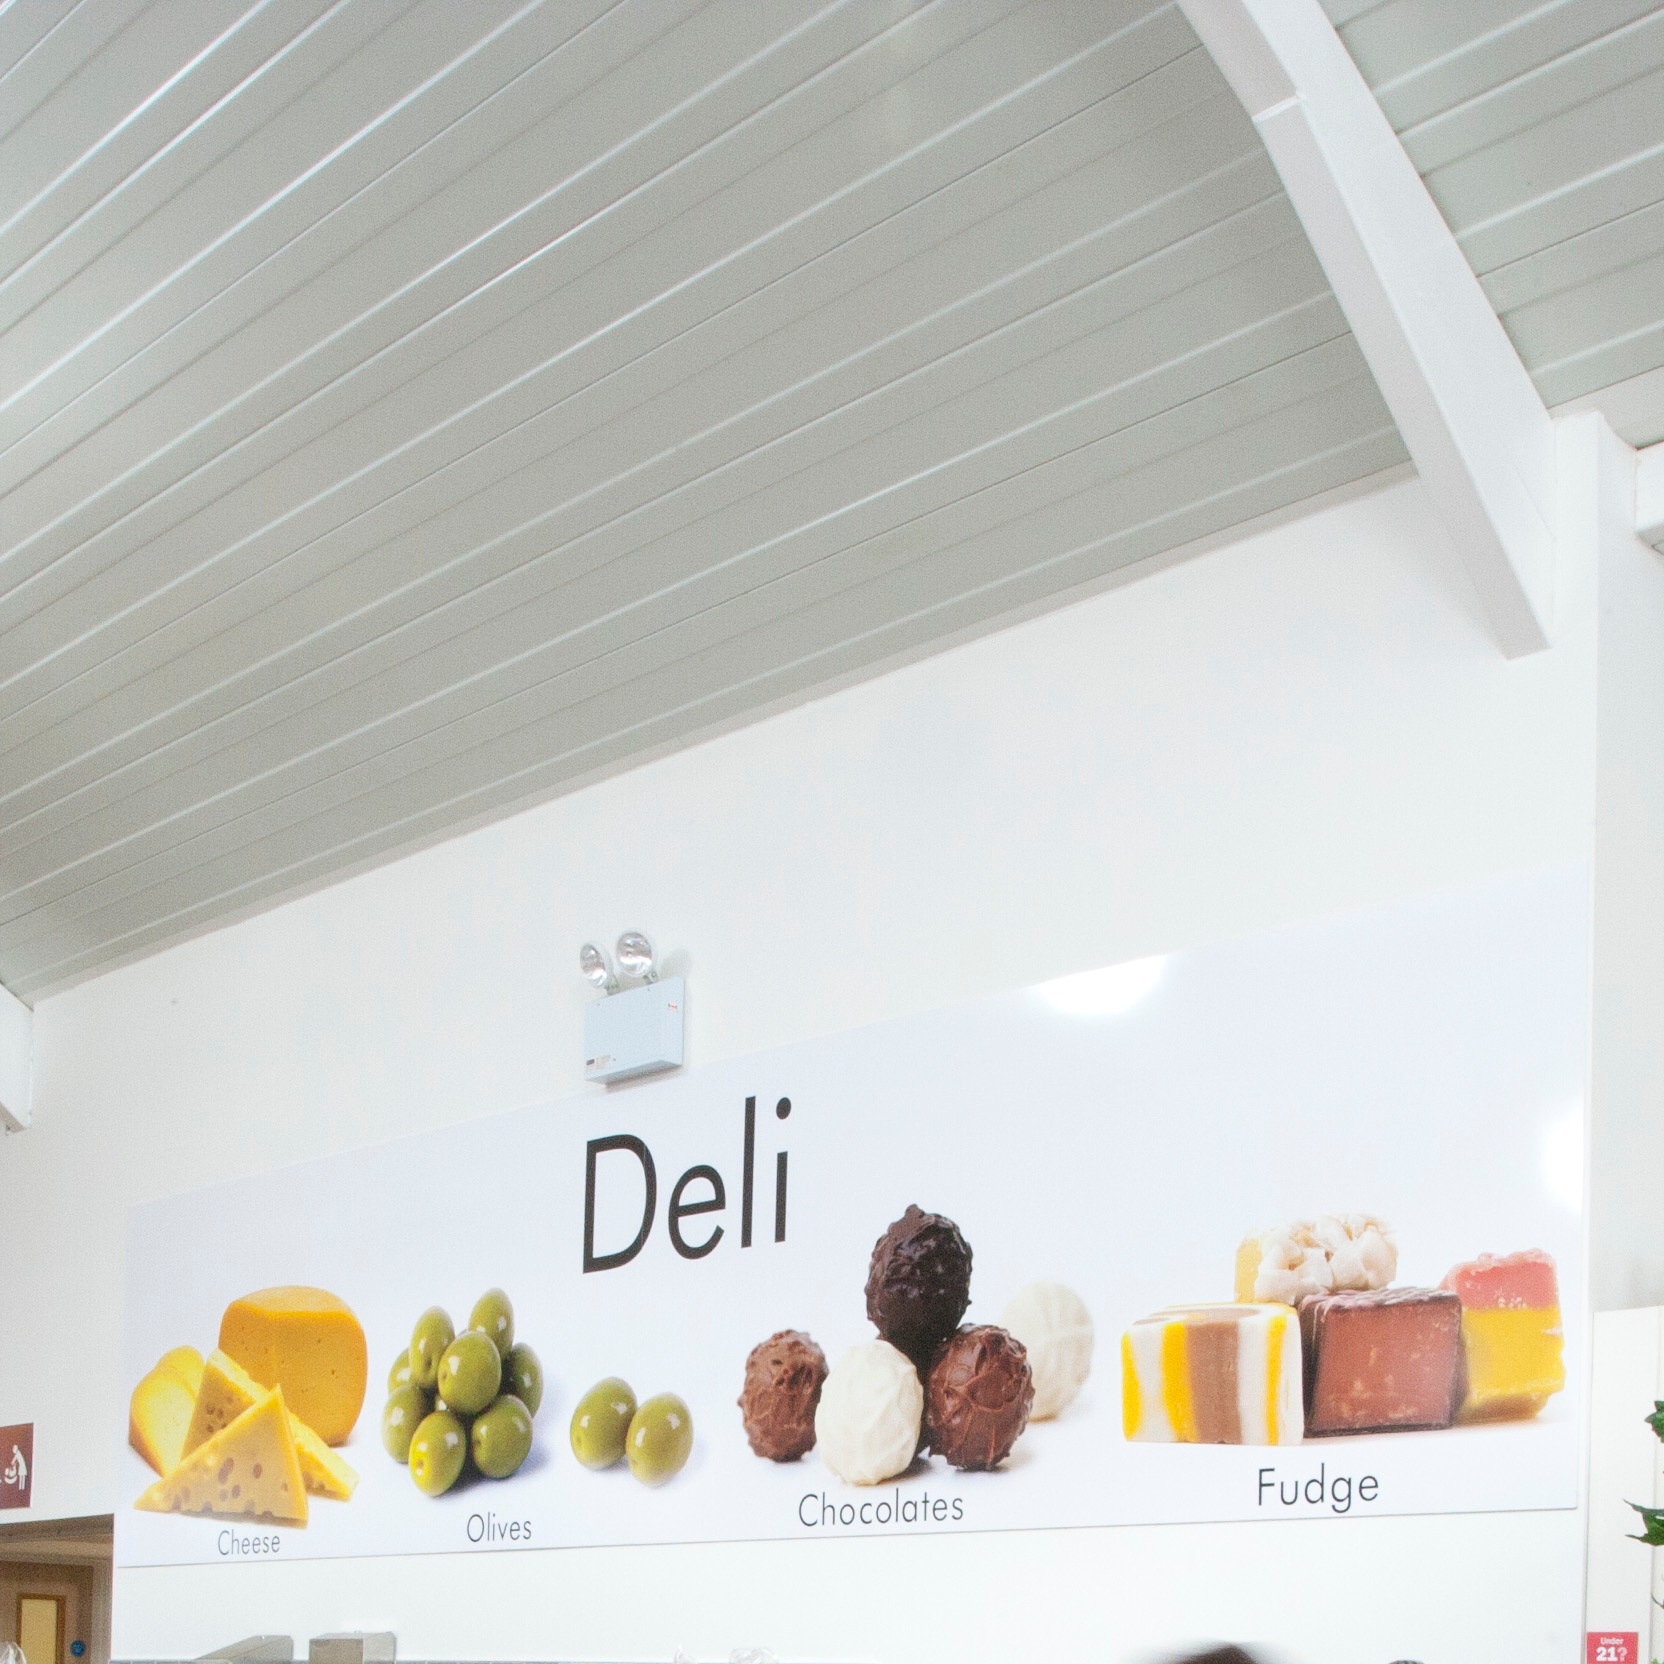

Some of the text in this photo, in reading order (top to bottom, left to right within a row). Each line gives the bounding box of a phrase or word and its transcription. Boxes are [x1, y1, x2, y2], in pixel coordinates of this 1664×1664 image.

[582, 1095, 792, 1274] Deli
[1258, 1463, 1380, 1514] Fudge
[798, 1487, 964, 1529] Chocolates
[467, 1512, 532, 1543] Olives
[217, 1529, 282, 1558] Cheese
[1596, 1646, 1628, 1662] 21?
[1600, 1637, 1624, 1646] Under
